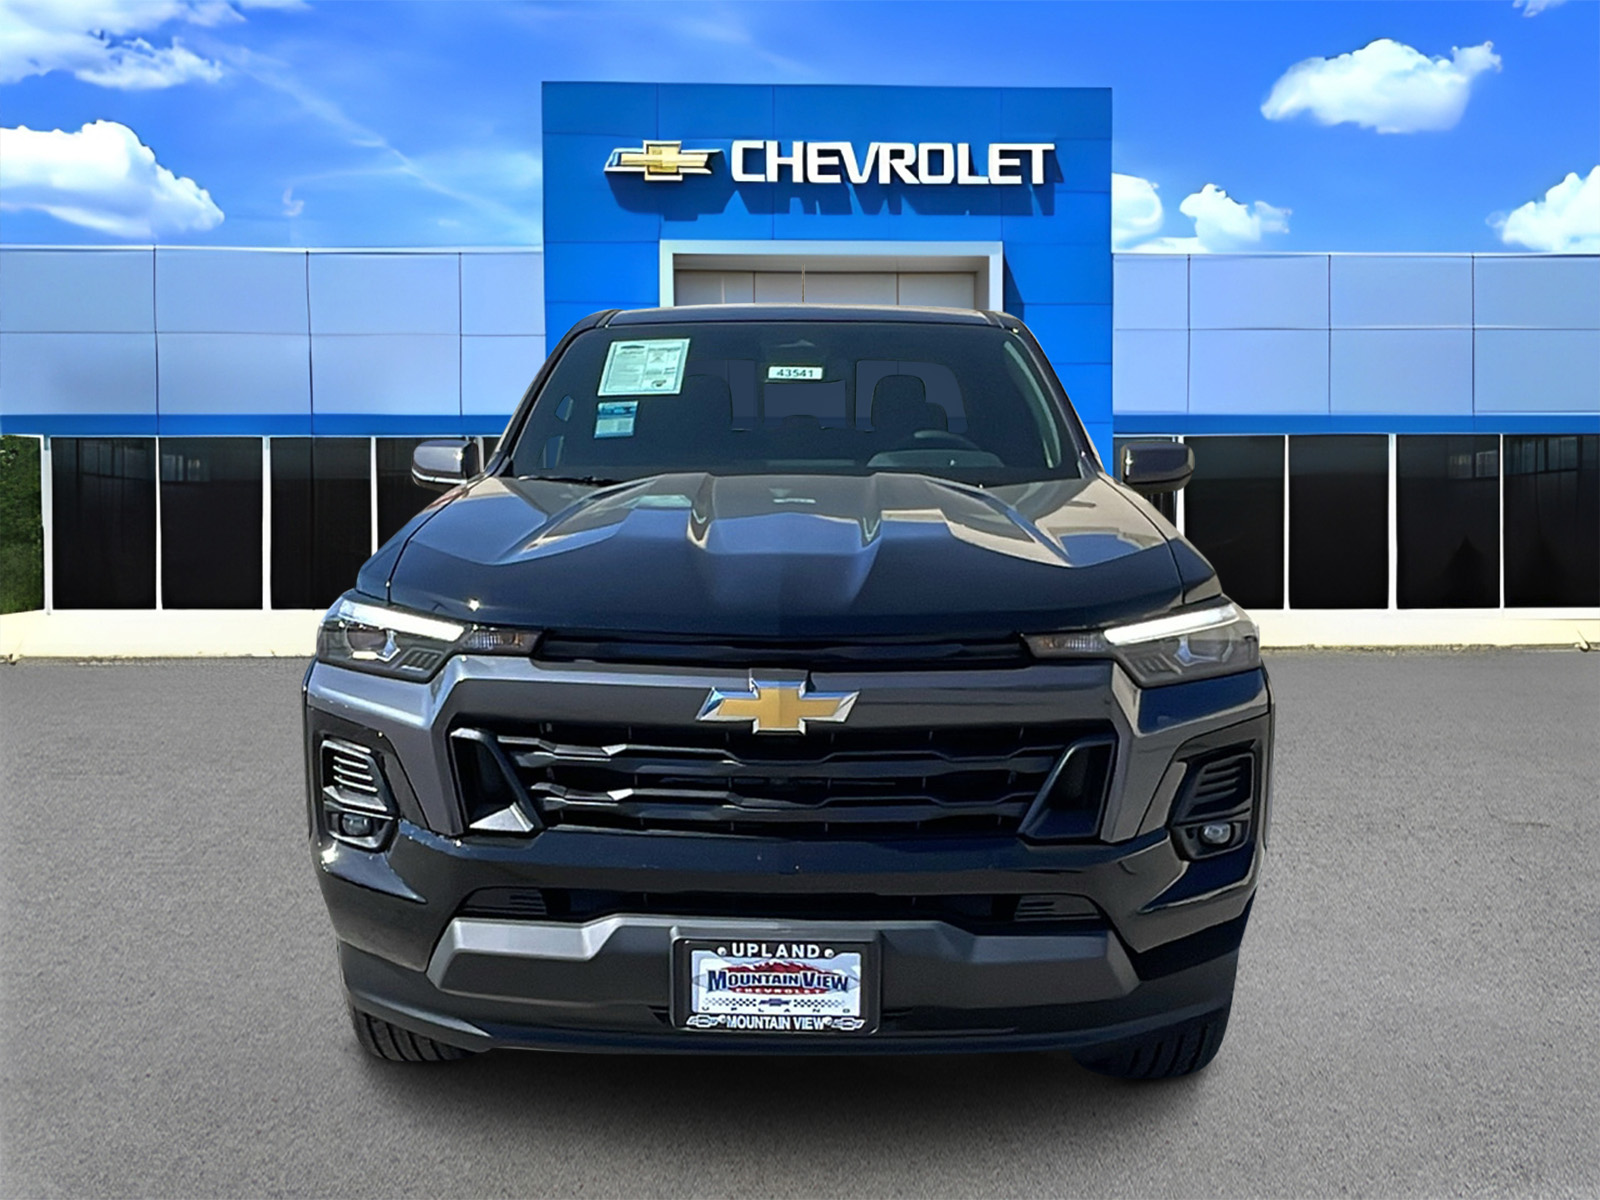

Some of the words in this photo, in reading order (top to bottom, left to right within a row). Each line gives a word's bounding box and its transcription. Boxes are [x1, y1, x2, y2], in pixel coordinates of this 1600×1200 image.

[731, 140, 1055, 185] CHEVROLET
[775, 368, 814, 378] 43541
[731, 942, 820, 958] UPLAND
[706, 969, 799, 992] MOUNTAIN
[800, 971, 849, 993] VIEW
[726, 1015, 791, 1030] MOUNTAIN
[793, 1016, 825, 1030] VIEW
